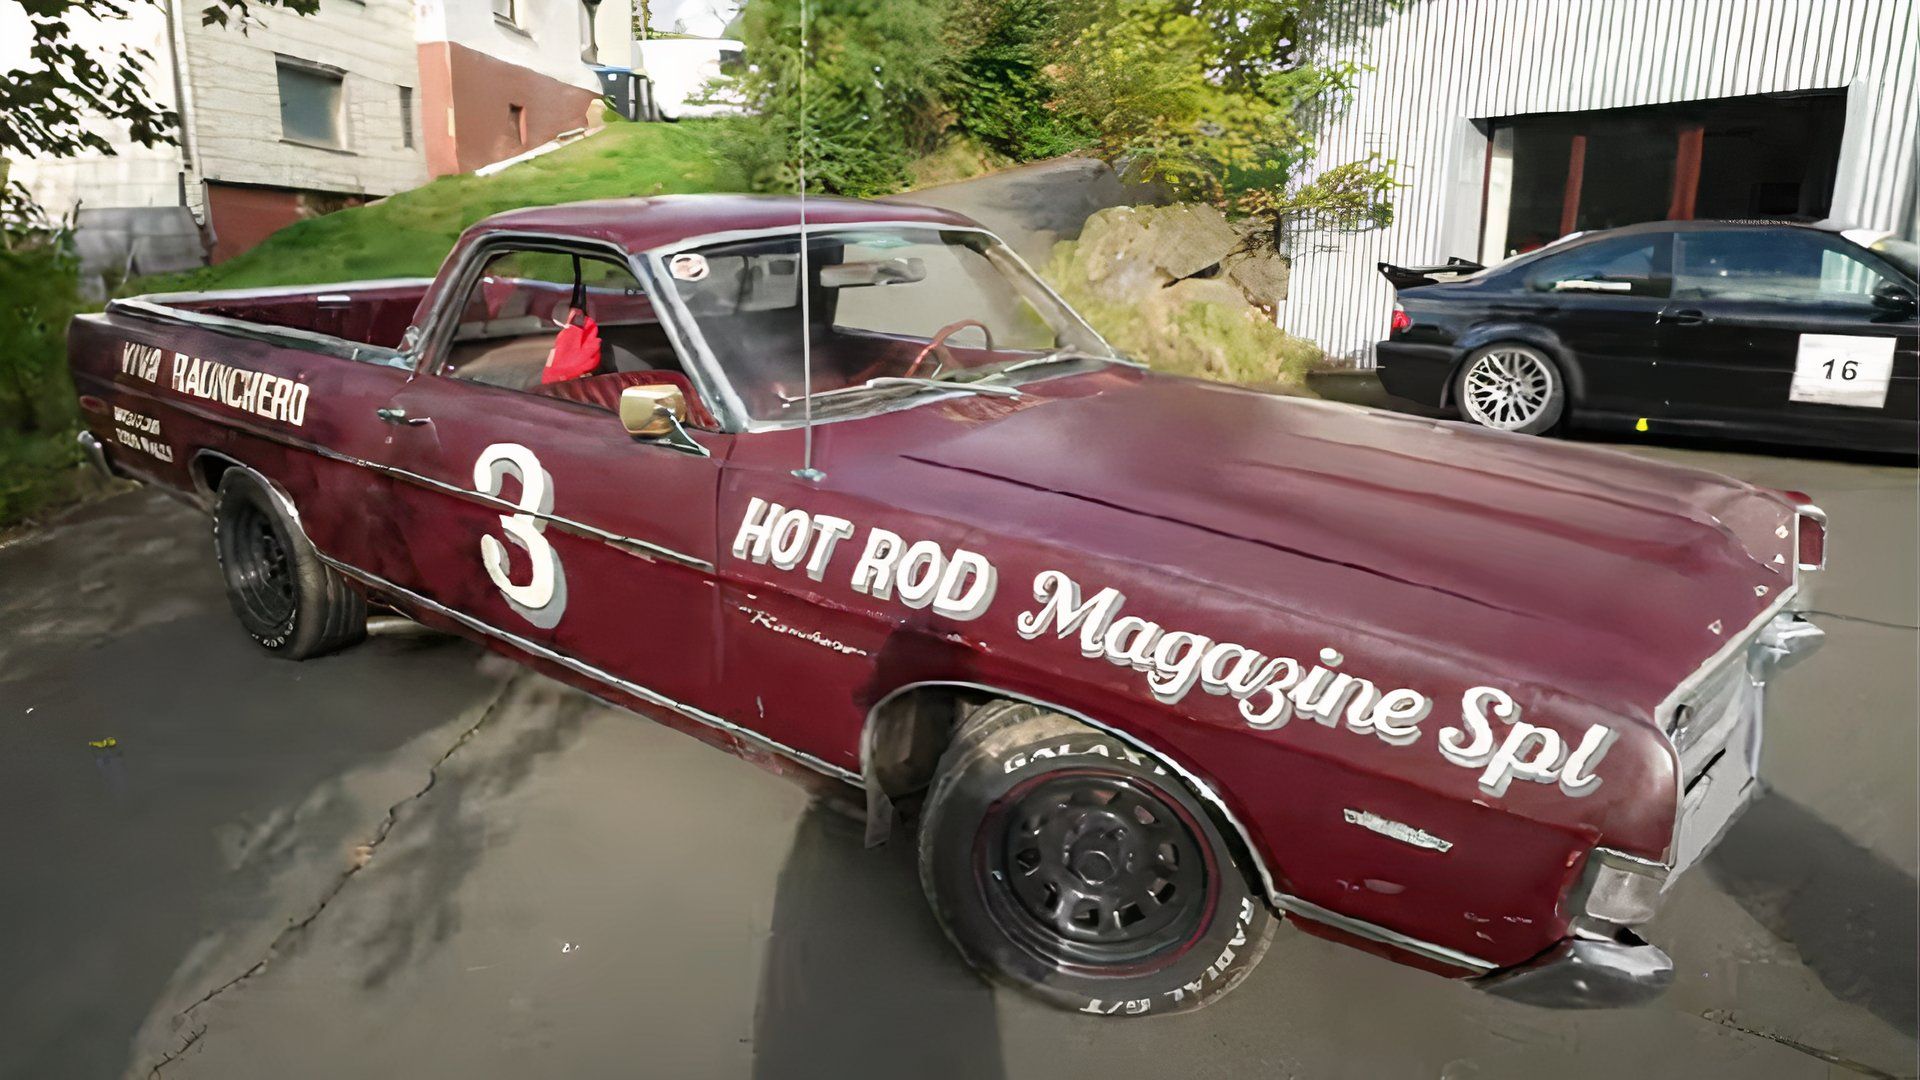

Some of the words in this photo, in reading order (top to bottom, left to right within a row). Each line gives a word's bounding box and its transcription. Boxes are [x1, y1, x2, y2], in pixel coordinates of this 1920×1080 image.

[121, 341, 162, 384] VIVA
[171, 352, 310, 427] RAUNCHERO
[1822, 358, 1859, 381] 16
[474, 443, 568, 629] 3
[732, 496, 854, 582] HOT
[851, 527, 997, 621] ROD
[1017, 569, 1433, 746] Magazine
[1438, 686, 1618, 797] Spl
